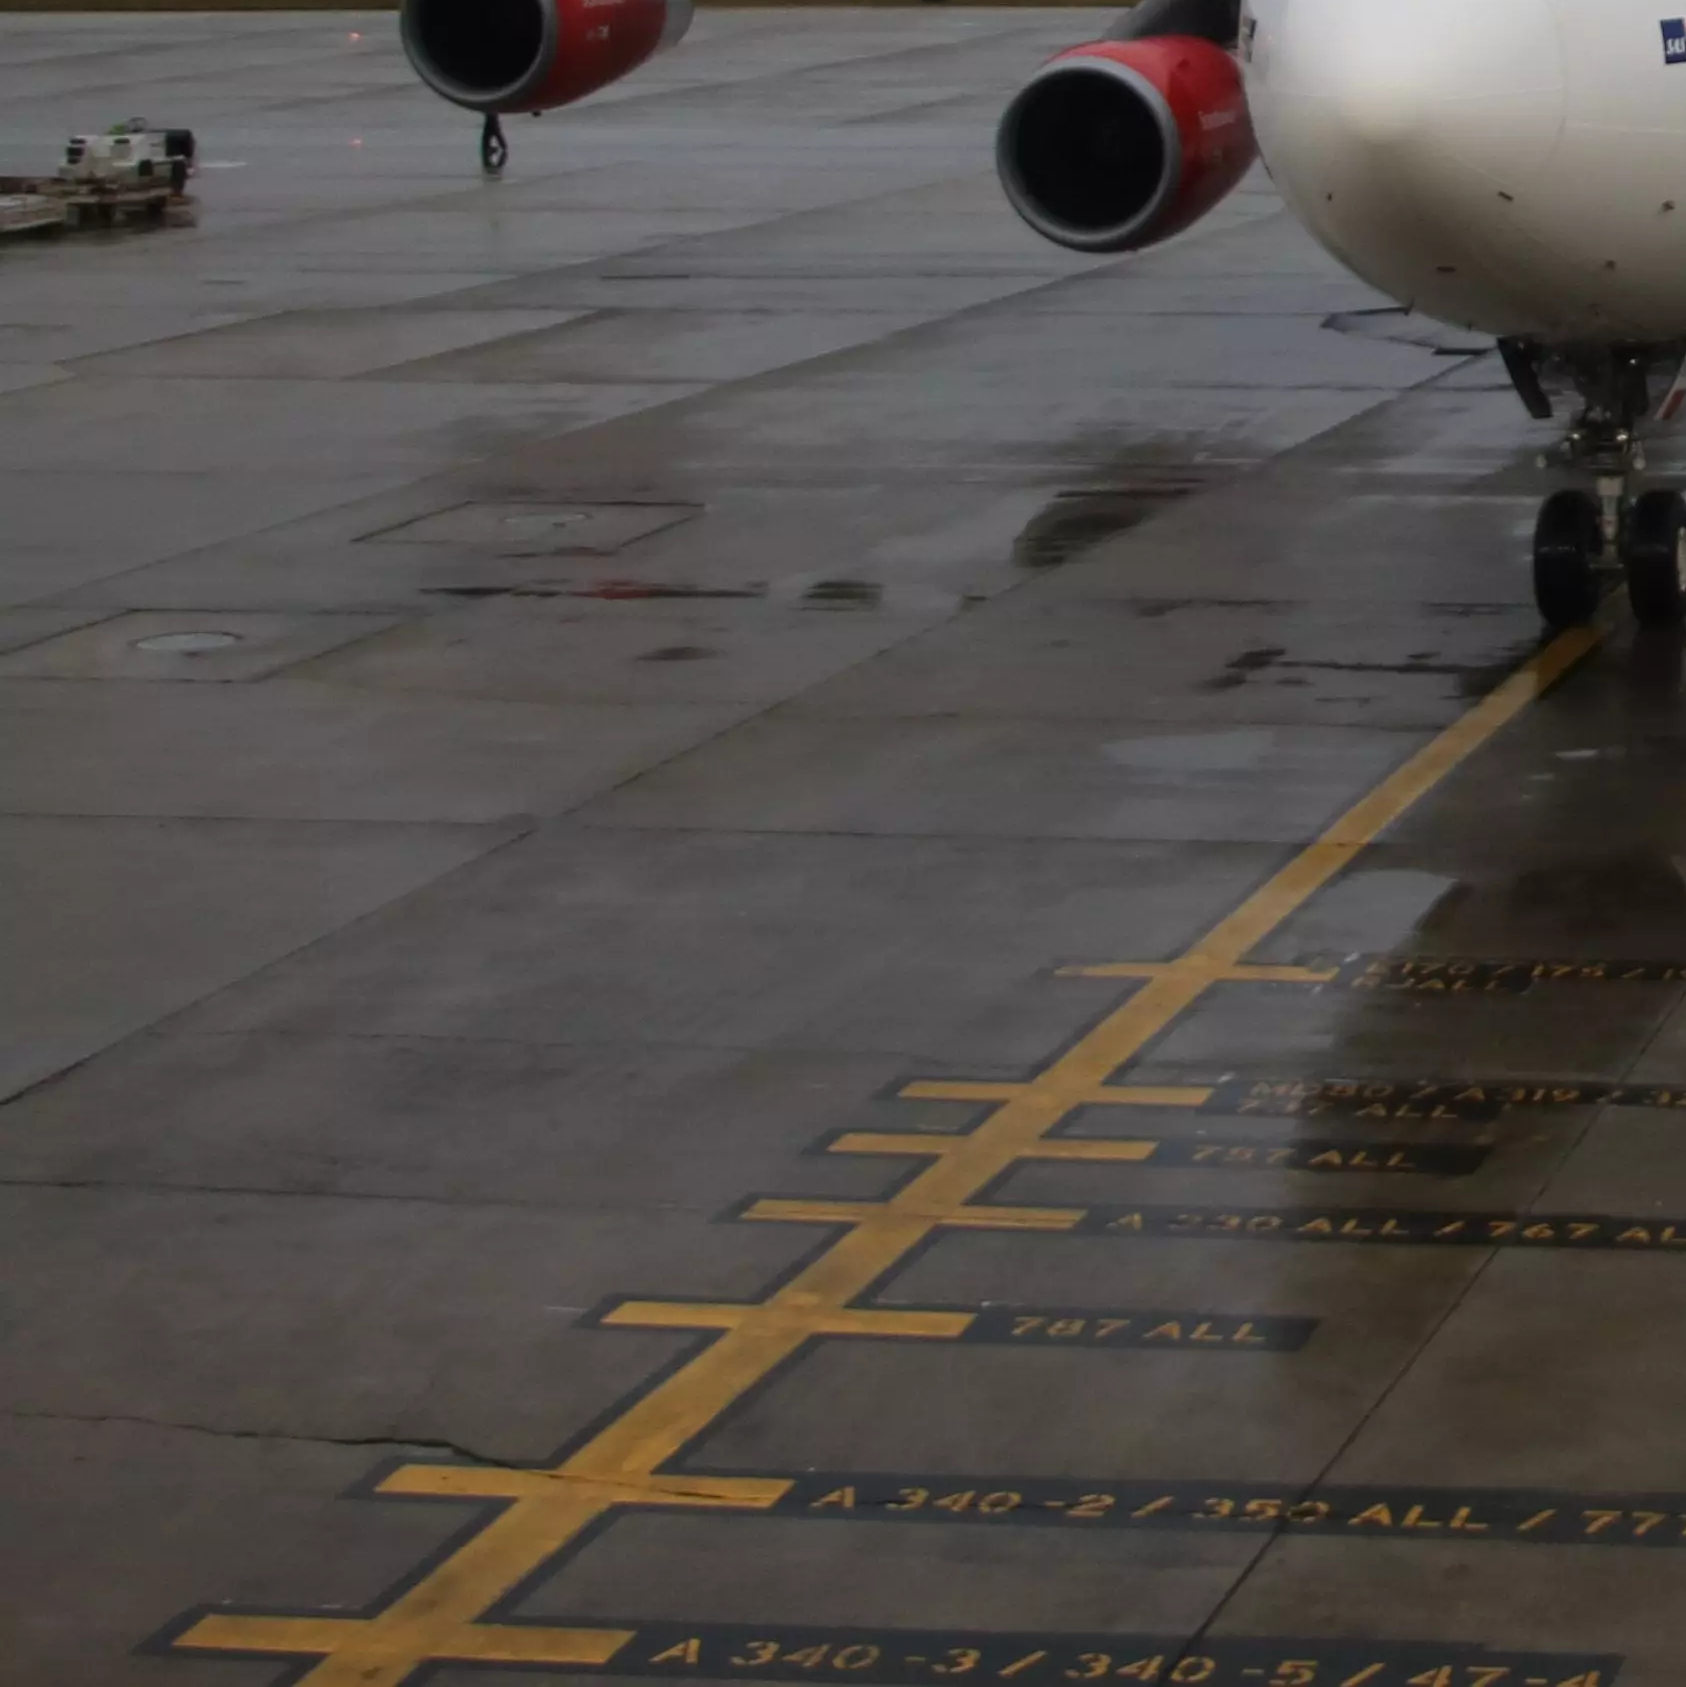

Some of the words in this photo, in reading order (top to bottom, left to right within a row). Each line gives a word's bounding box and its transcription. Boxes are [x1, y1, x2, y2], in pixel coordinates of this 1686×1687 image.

[1353, 1102, 1458, 1119] ALL
[1191, 1145, 1298, 1164] 757
[1306, 1149, 1417, 1167] ALL
[1294, 1216, 1409, 1236] ALL
[1488, 1221, 1600, 1240] 767
[1010, 1316, 1131, 1339] 787
[1141, 1320, 1266, 1343] ALL
[1346, 1502, 1490, 1531] ALL
